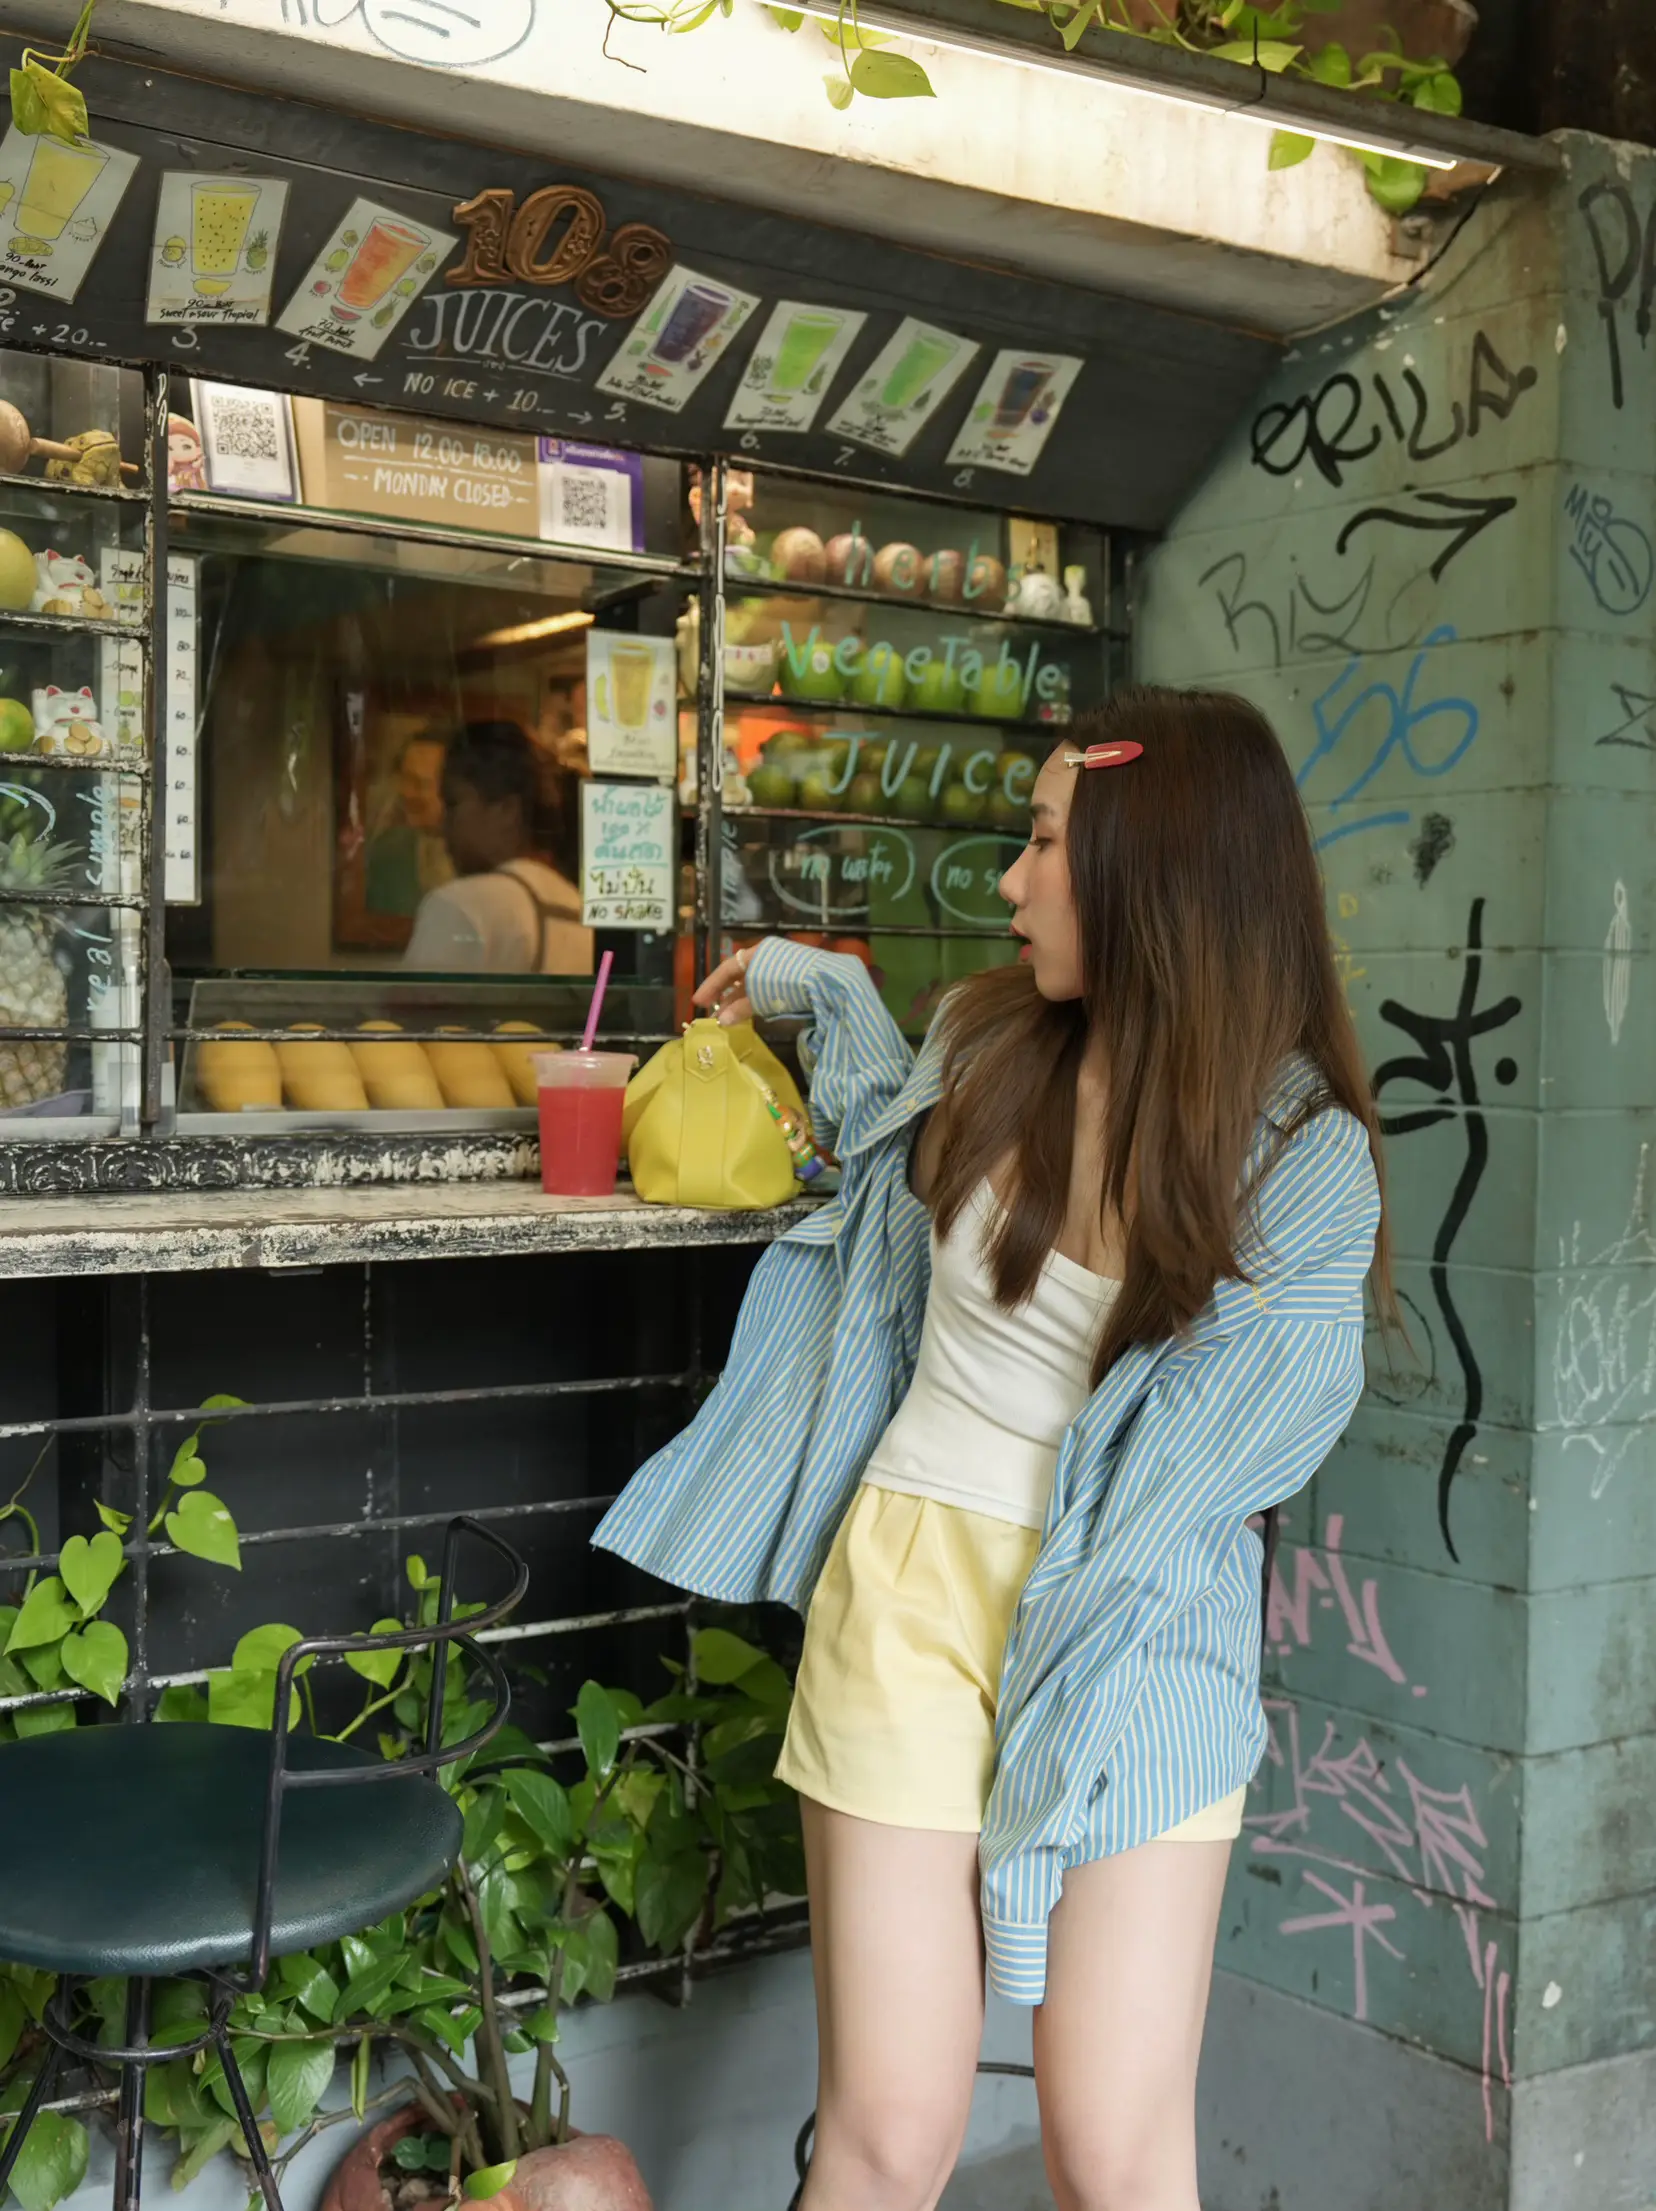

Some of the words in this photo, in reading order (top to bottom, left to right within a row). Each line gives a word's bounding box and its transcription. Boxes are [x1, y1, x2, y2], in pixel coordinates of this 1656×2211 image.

[29, 271, 58, 287] lassi
[405, 289, 608, 375] JUICES
[284, 341, 312, 370] 4.
[403, 372, 436, 396] NO
[443, 378, 480, 400] ICE
[338, 419, 397, 453] OPEN
[373, 467, 450, 500] MONDAY
[453, 477, 513, 508] CLOSED
[844, 519, 1022, 602] herbs
[946, 864, 972, 891] no
